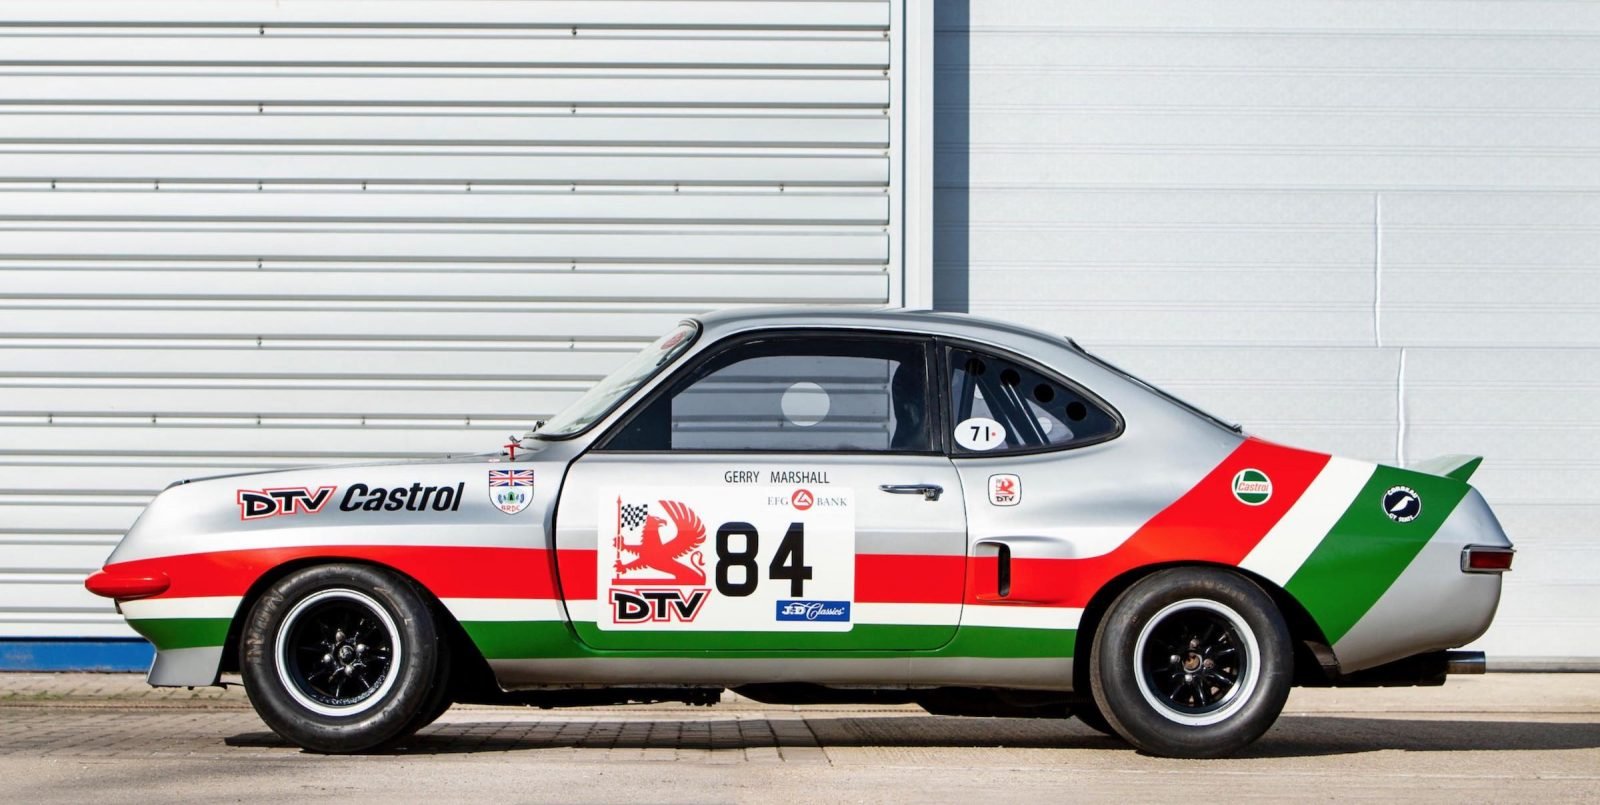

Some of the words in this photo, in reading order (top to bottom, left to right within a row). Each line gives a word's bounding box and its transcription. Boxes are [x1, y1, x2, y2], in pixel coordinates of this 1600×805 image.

[970, 425, 990, 442] 71
[724, 470, 760, 484] GERRY
[770, 471, 830, 484] MARSHALL
[1238, 481, 1269, 492] Castrol
[240, 488, 333, 517] DTV
[339, 481, 465, 512] Castrol
[767, 496, 789, 506] EFG
[816, 497, 848, 507] BANK
[715, 521, 813, 598] 84
[611, 590, 708, 621] DTV
[806, 602, 845, 620] Classics
